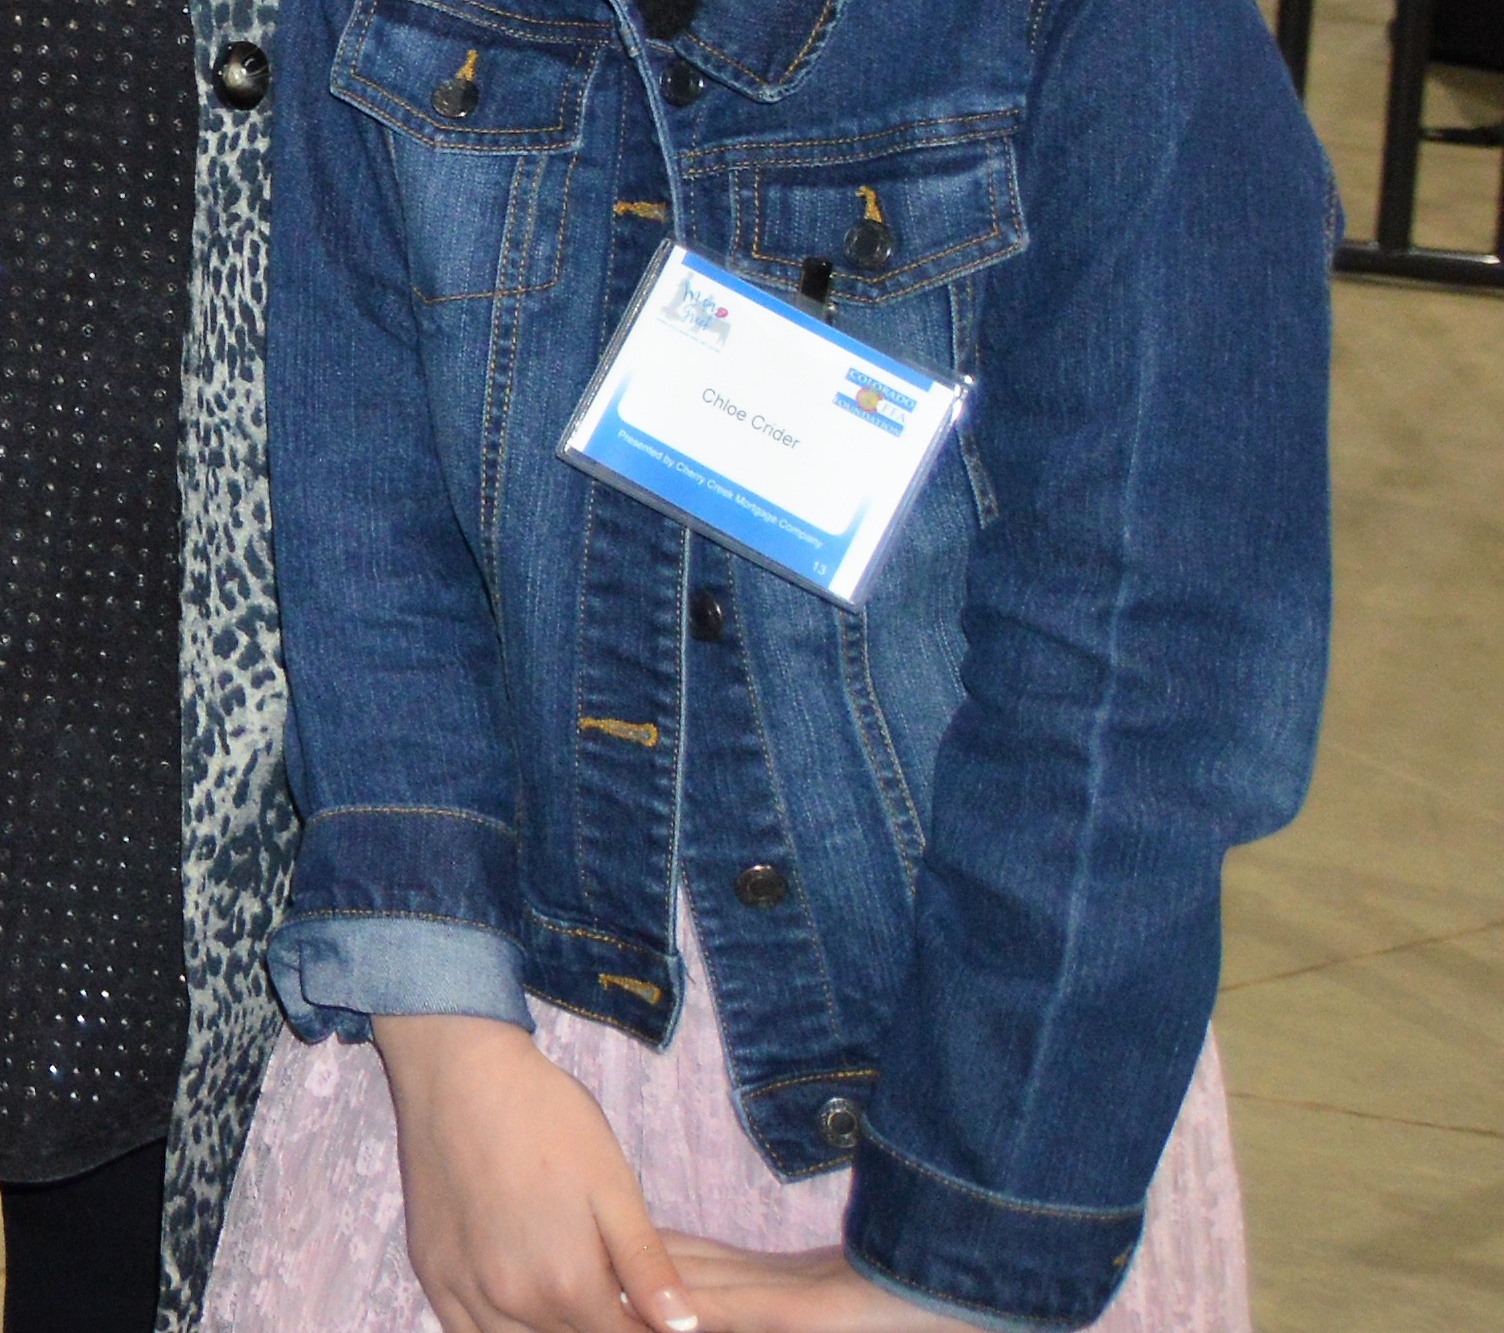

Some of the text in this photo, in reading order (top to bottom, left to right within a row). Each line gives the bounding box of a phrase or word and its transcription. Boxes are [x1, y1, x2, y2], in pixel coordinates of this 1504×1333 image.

[849, 370, 916, 411] COLORADO
[702, 388, 801, 449] Chloe Crider
[618, 429, 823, 549] Presented by Cherry Creek Mortgage Company
[812, 561, 827, 576] 13
